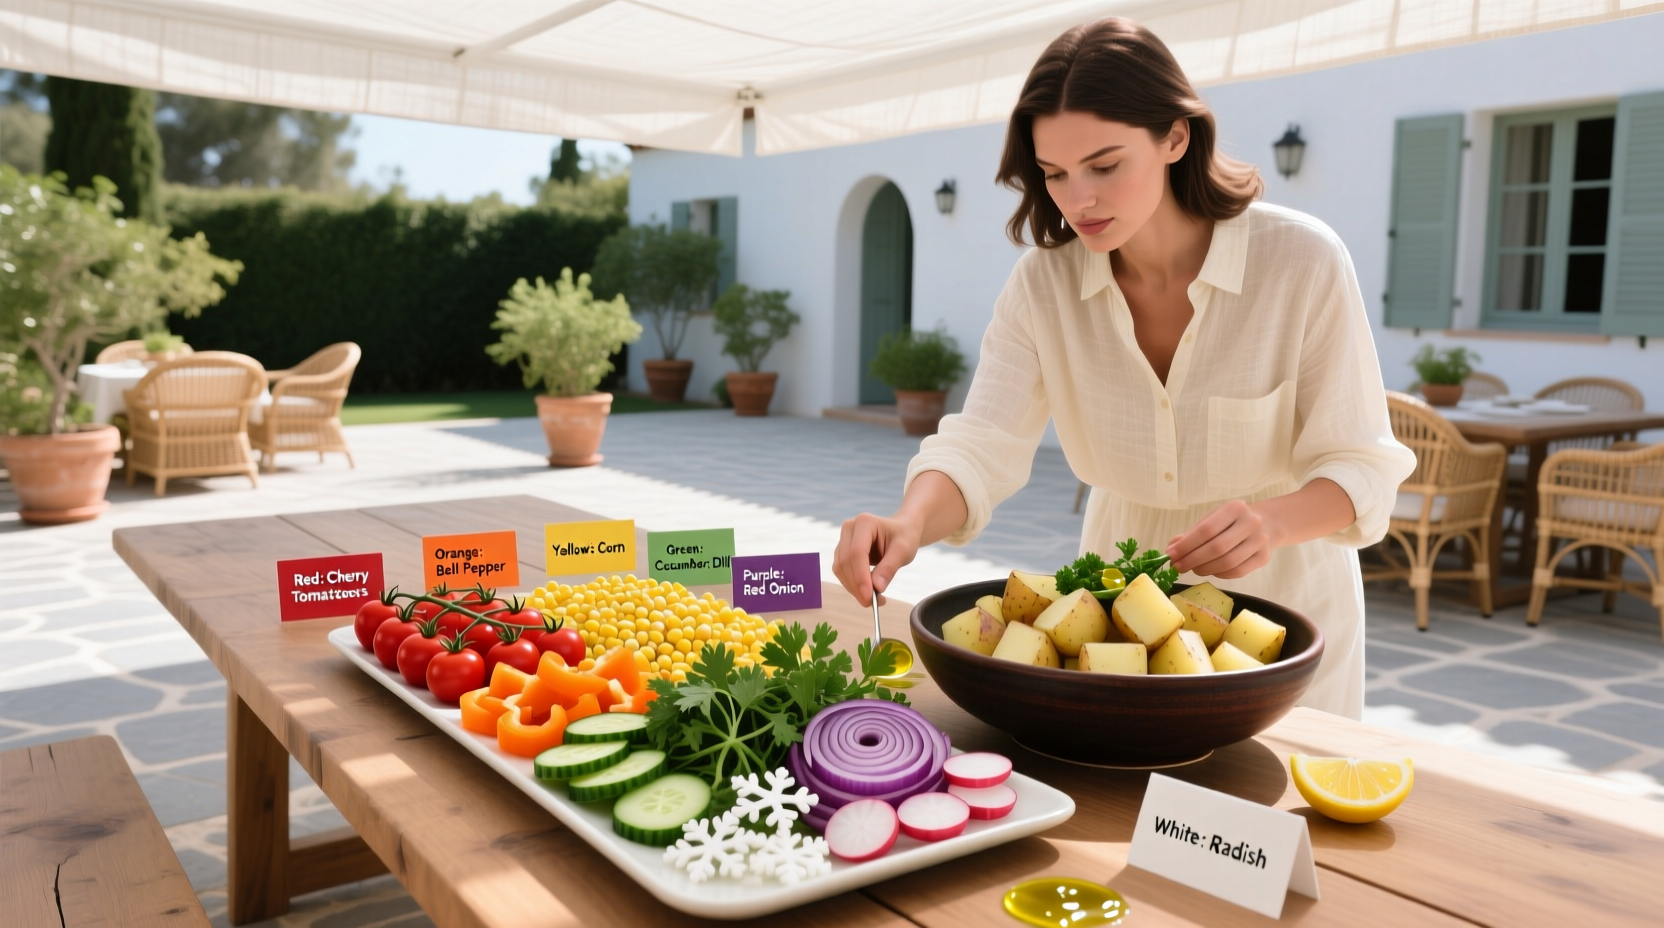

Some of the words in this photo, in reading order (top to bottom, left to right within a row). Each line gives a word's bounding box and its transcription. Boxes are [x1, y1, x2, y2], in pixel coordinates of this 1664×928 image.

[435, 548, 483, 561] Orange:
[597, 541, 625, 554] Corn
[436, 562, 459, 576] Bell
[463, 562, 506, 577] Pepper
[743, 566, 785, 582] Purple:
[293, 571, 324, 587] Red:
[326, 568, 369, 585] Cherry
[743, 582, 766, 596] Red
[769, 581, 804, 596] Onion
[1155, 815, 1207, 849] White:
[1209, 834, 1267, 870] Radish
